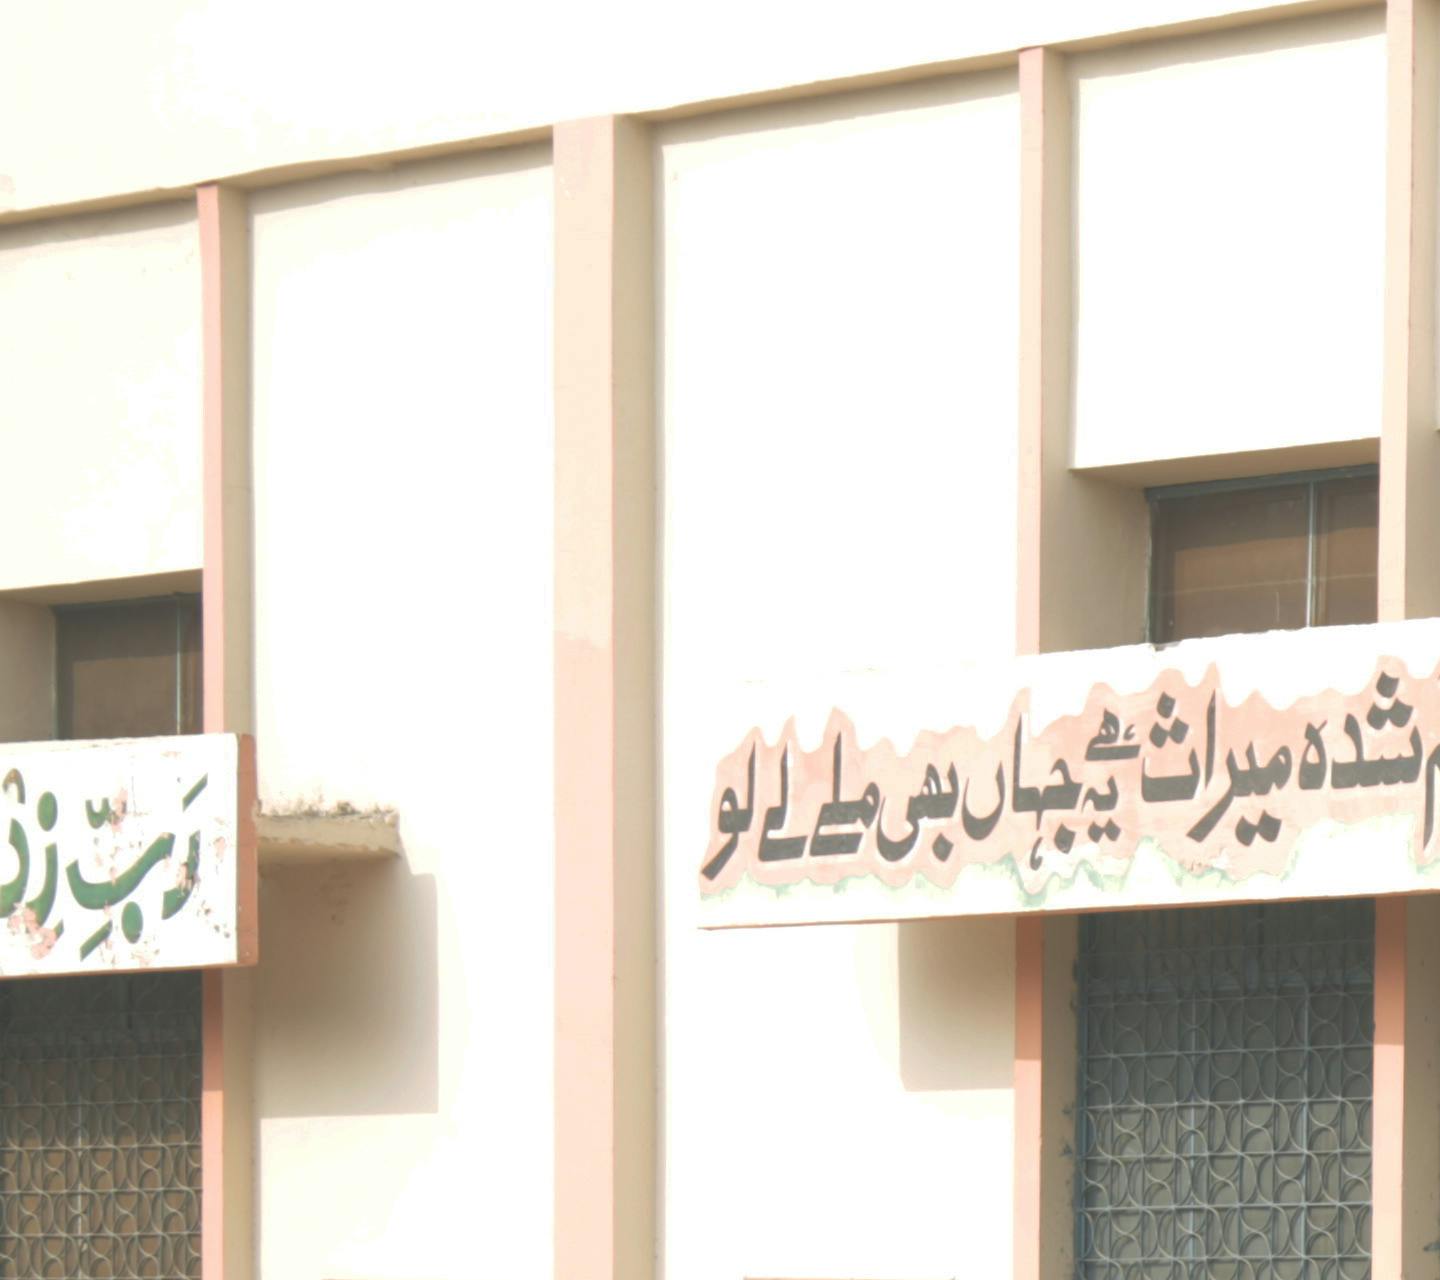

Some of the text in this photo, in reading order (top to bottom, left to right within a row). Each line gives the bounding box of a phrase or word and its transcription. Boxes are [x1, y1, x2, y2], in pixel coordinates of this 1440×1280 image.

[700, 741, 756, 881] لو
[758, 741, 808, 863] لے
[809, 732, 880, 858] ملے
[876, 760, 960, 863] بھی
[961, 711, 1083, 871] جہاں
[1081, 774, 1121, 843] یہ
[1141, 690, 1292, 847] میراث
